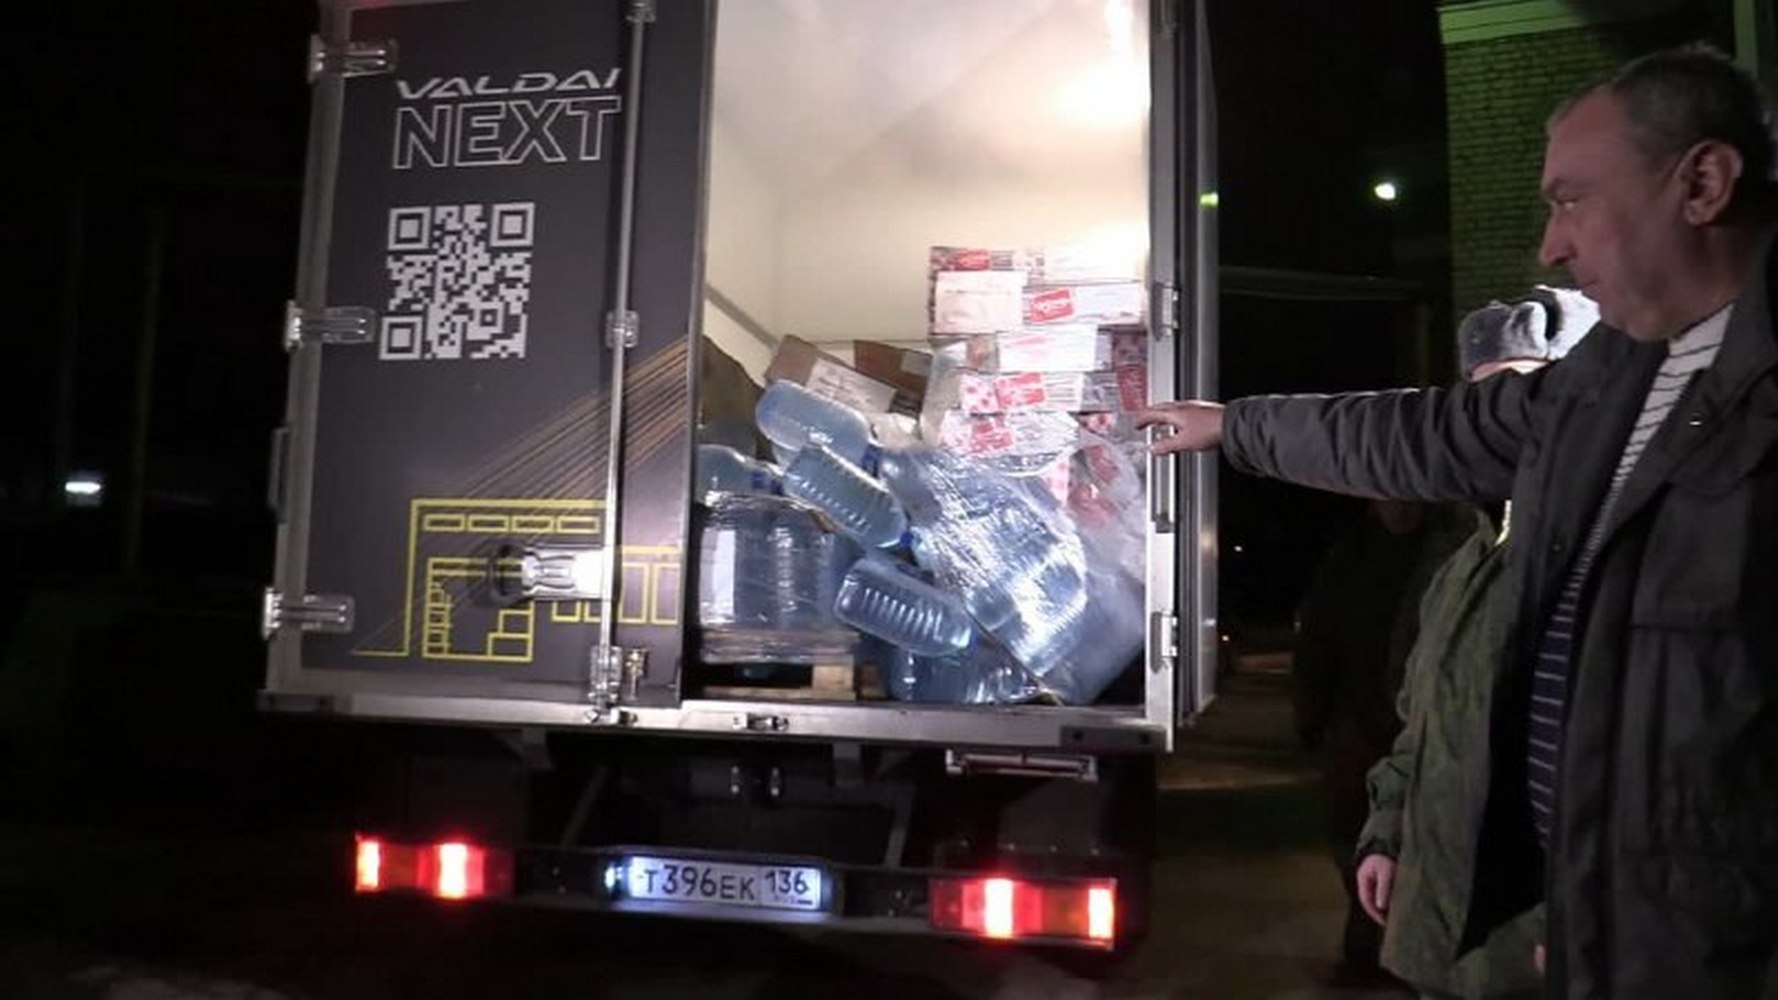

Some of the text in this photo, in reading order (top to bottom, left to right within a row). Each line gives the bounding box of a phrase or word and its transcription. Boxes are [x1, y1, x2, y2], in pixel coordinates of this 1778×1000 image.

[397, 68, 621, 99] VALDAI
[393, 96, 621, 169] NEXT
[764, 869, 809, 895] 136
